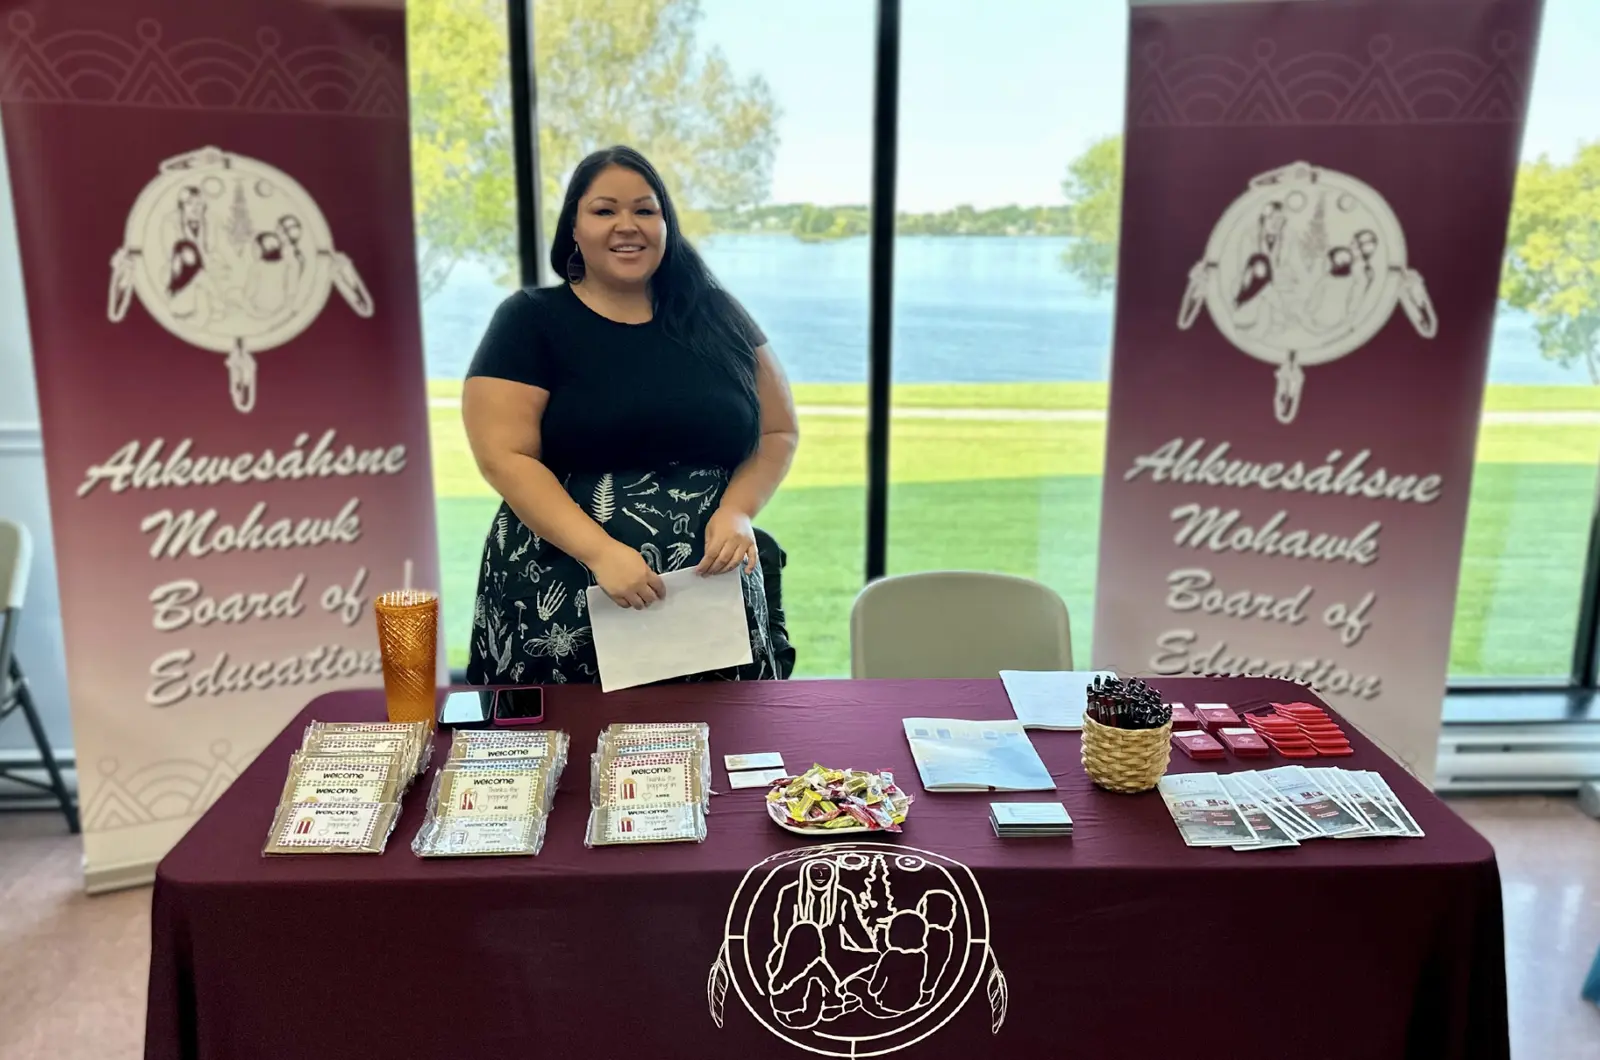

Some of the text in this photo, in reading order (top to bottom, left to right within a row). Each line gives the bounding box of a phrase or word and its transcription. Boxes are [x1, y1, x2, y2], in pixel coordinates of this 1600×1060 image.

[76, 429, 407, 497] Ahkwesáhsne
[1124, 437, 1443, 504] Ahkwesáhsne
[140, 497, 361, 559] Mohawk
[1170, 503, 1382, 565] Mohawk
[149, 566, 368, 632] Board of
[1165, 567, 1376, 647] Board of
[1150, 628, 1382, 701] Education
[487, 749, 529, 757] welcome
[631, 767, 671, 775] welcome
